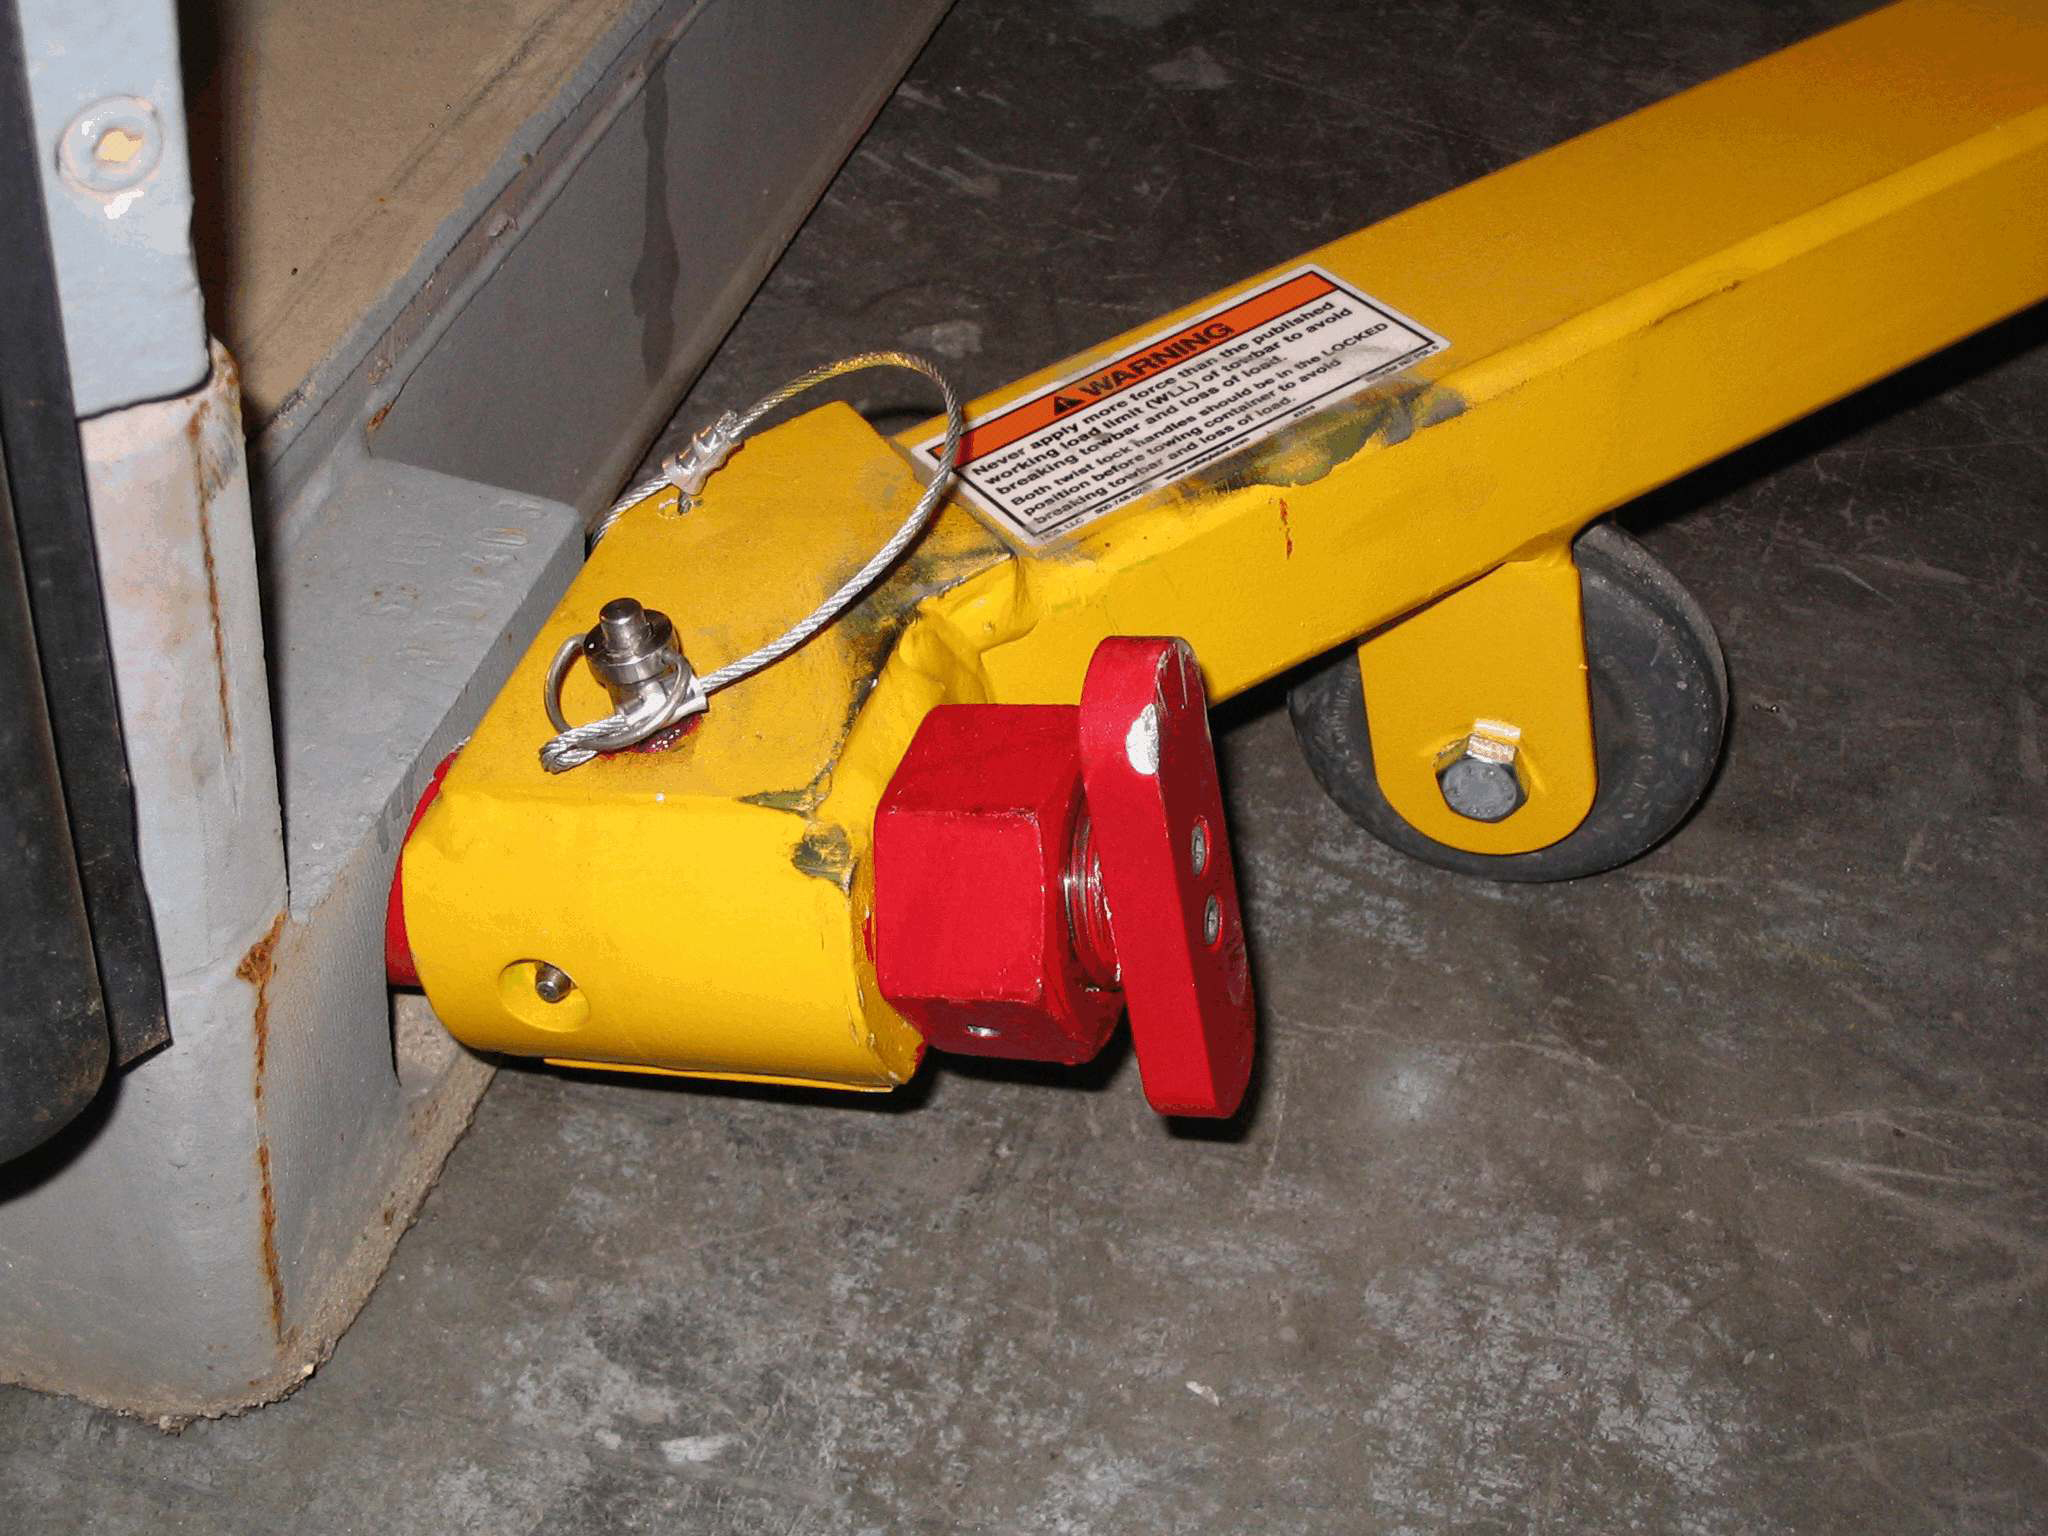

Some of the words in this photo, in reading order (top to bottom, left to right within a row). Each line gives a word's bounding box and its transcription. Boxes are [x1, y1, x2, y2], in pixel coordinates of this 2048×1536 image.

[971, 448, 1025, 476] Never
[1030, 423, 1078, 449] apply
[1082, 401, 1128, 424] more
[1129, 377, 1177, 401] force
[1177, 358, 1218, 378] than
[1219, 343, 1249, 358] the
[1251, 301, 1335, 345] published
[984, 448, 1060, 484] working
[1059, 427, 1102, 450] load
[1102, 407, 1144, 429] limit
[1145, 381, 1200, 409] (WLL)
[1201, 370, 1220, 382] of
[1221, 342, 1280, 372] towbar
[1283, 332, 1303, 343] to
[1306, 308, 1353, 333] avoid
[995, 454, 1079, 495] breaking
[1079, 423, 1140, 455] towbar
[1145, 405, 1179, 424] and
[1179, 387, 1220, 407] loss
[1222, 375, 1241, 387] of
[1241, 355, 1287, 377] load.
[1011, 485, 1052, 506] Both
[1054, 464, 1095, 485] twist
[1095, 446, 1133, 465] lock
[1130, 416, 1197, 448] handles
[1199, 388, 1253, 416] should
[1253, 378, 1275, 389] be
[1275, 369, 1293, 379] in
[1294, 356, 1321, 370] the
[1321, 323, 1388, 357] LOCKED
[1023, 481, 1091, 516] position
[1091, 454, 1145, 482] before
[1146, 427, 1203, 455] towing
[1204, 390, 1276, 428] container
[1278, 382, 1296, 391] to
[1299, 358, 1342, 382] avoid
[1080, 322, 1234, 396] WARNING
[1033, 487, 1108, 524] breaking
[1108, 458, 1163, 488] towbar
[1167, 441, 1199, 460] and
[1198, 425, 1235, 444] loss
[1237, 413, 1254, 426] of
[1254, 397, 1296, 417] load.
